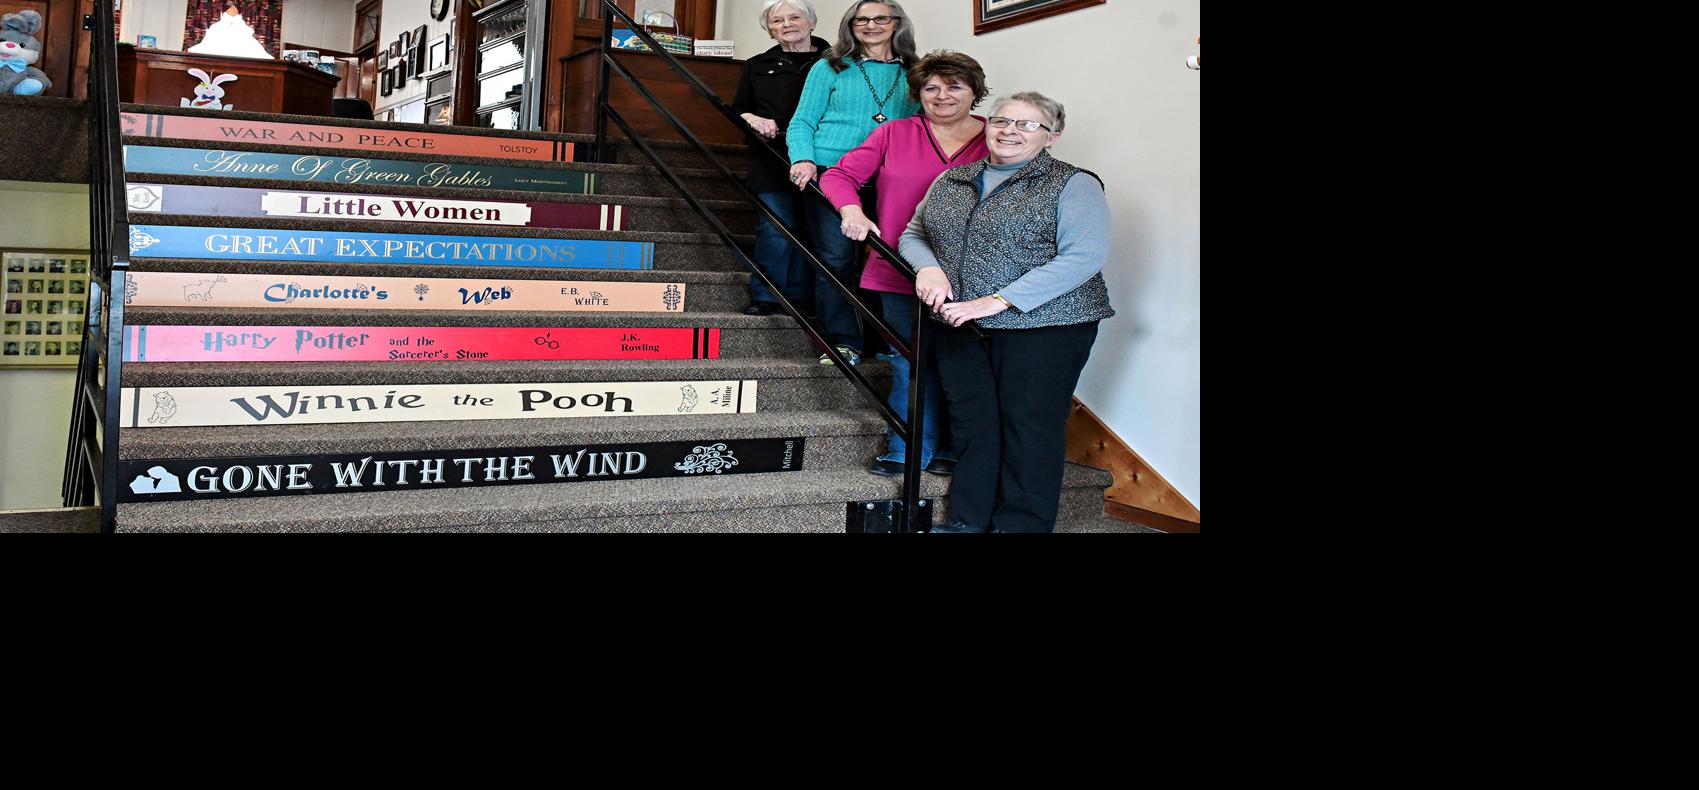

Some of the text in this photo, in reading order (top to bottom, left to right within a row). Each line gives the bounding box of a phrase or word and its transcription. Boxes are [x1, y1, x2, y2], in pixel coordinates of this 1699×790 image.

[219, 126, 435, 150] WAR AND PEACE
[499, 144, 538, 154] TOLSTOY
[193, 149, 492, 188] Anne Of Green Gables
[296, 195, 502, 222] Little Women
[204, 233, 576, 261] GREAT EXPECTATIONS
[263, 282, 512, 305] Charlotte's Web
[560, 287, 580, 296] E.B.
[574, 297, 609, 306] WHITE
[200, 329, 370, 355] Harry Potter
[389, 336, 435, 346] and the
[621, 333, 641, 342] J.K.
[621, 344, 660, 353] Rowling
[388, 349, 489, 360] Sorcerer's Stone
[230, 389, 634, 422] Winnie the Pooh
[782, 440, 794, 469] Mitchell
[187, 449, 648, 494] GONE WITH THE WIND
